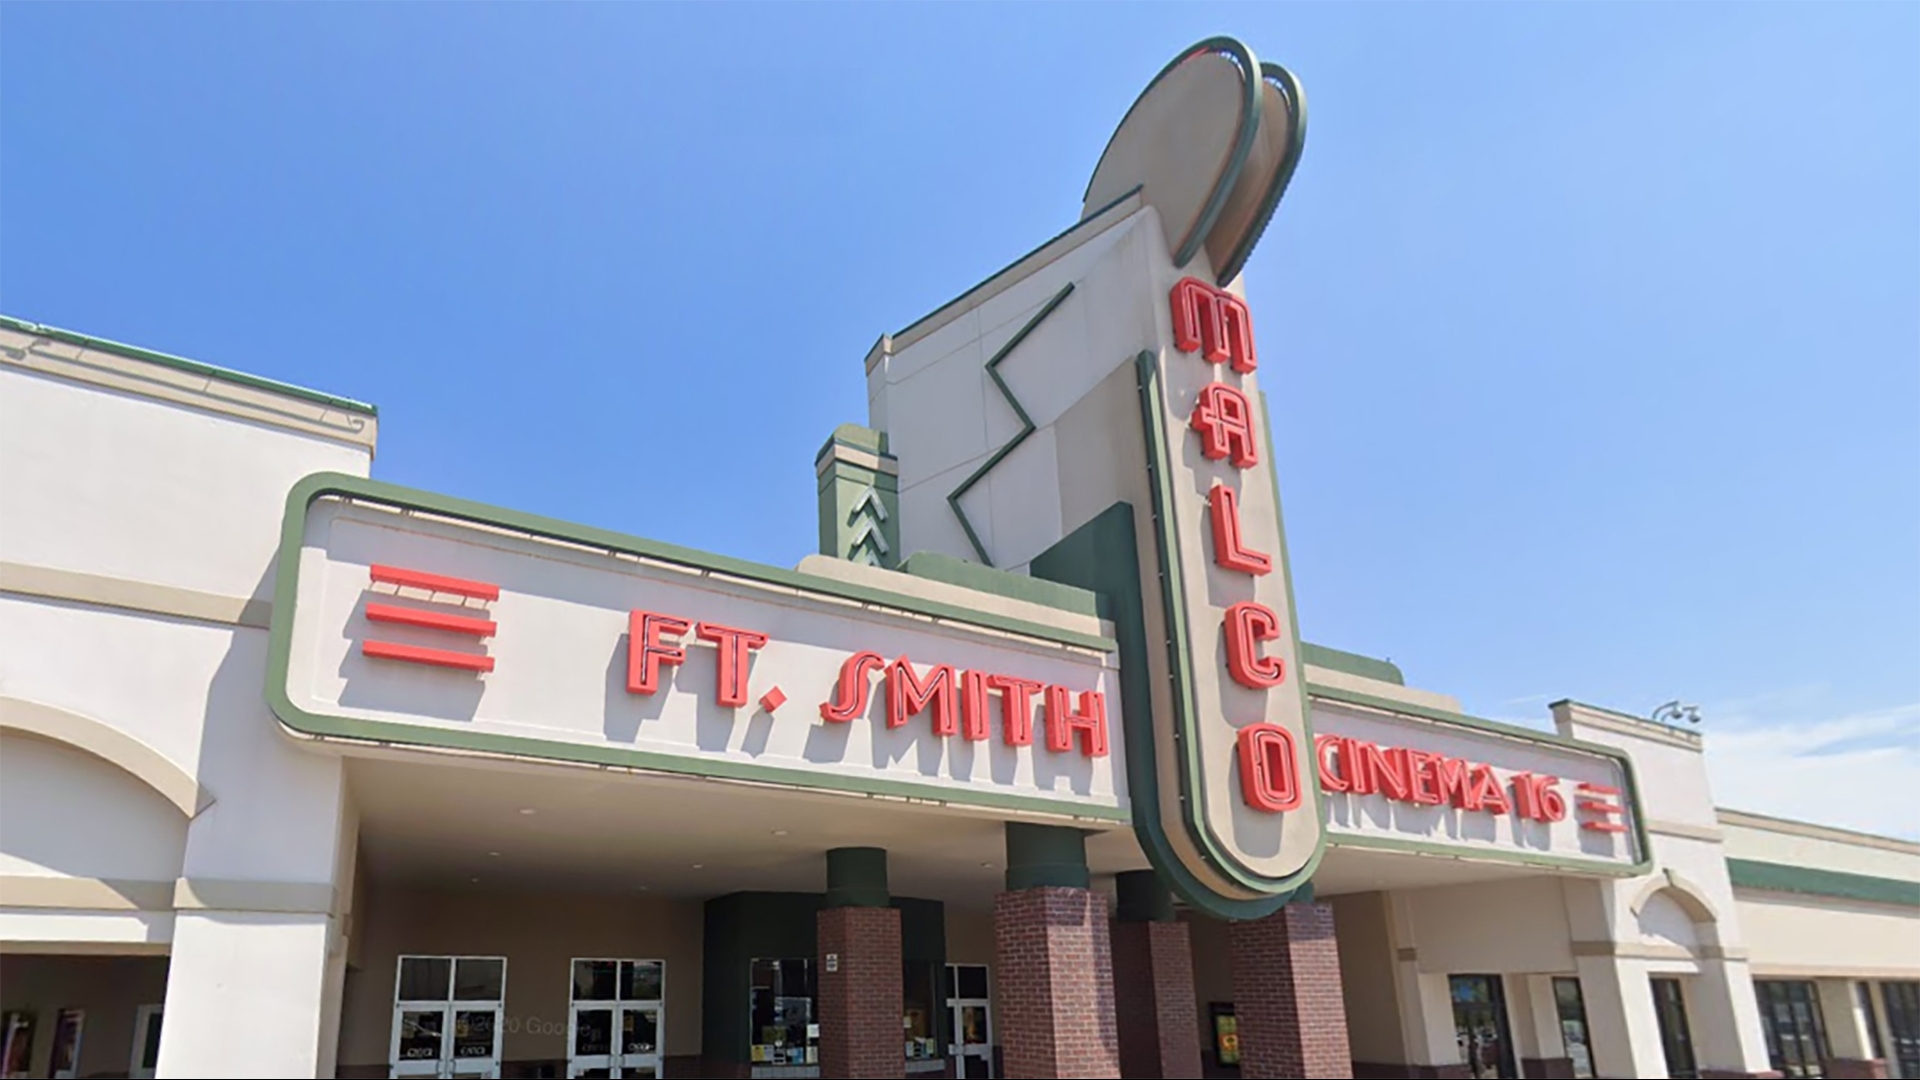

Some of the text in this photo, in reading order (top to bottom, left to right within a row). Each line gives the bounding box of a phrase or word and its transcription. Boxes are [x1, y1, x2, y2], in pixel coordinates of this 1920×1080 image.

[1170, 276, 1301, 813] MALCO
[626, 609, 1110, 758] FT. SMITH
[1315, 735, 1565, 822] CINEMA 16
